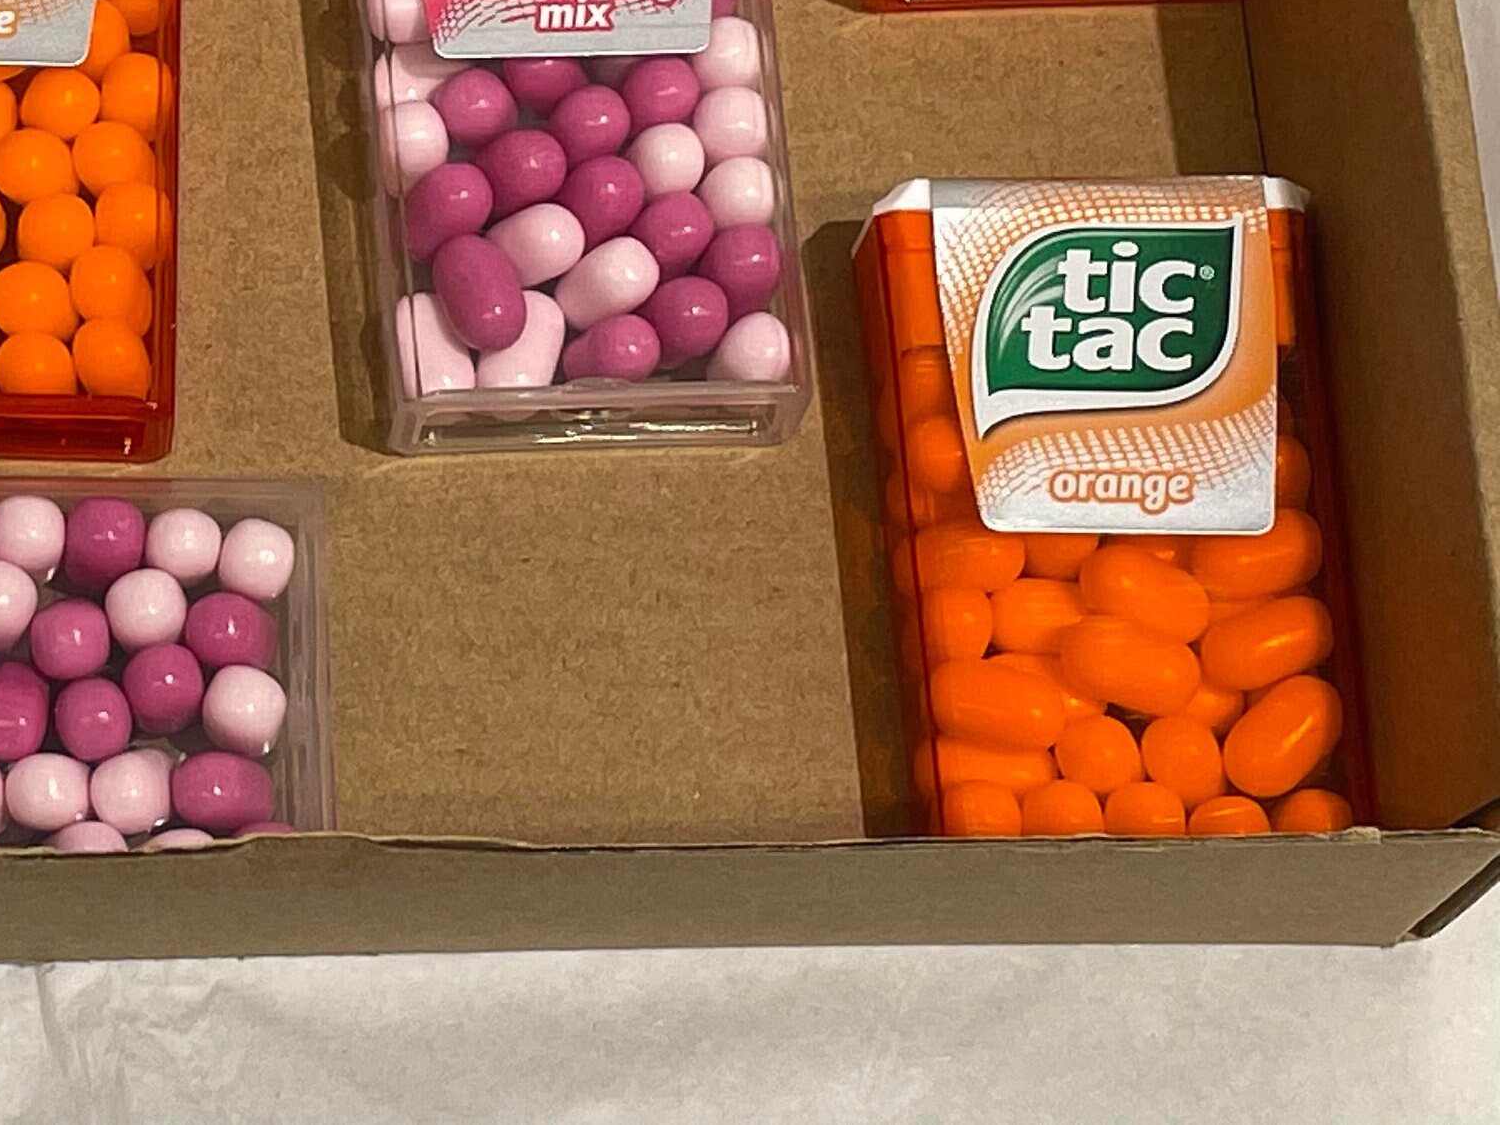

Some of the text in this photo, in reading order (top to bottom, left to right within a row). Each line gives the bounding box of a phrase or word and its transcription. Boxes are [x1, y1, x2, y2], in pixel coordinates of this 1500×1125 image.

[1057, 241, 1196, 313] tic
[1021, 306, 1194, 371] tac
[1053, 471, 1191, 510] orange
